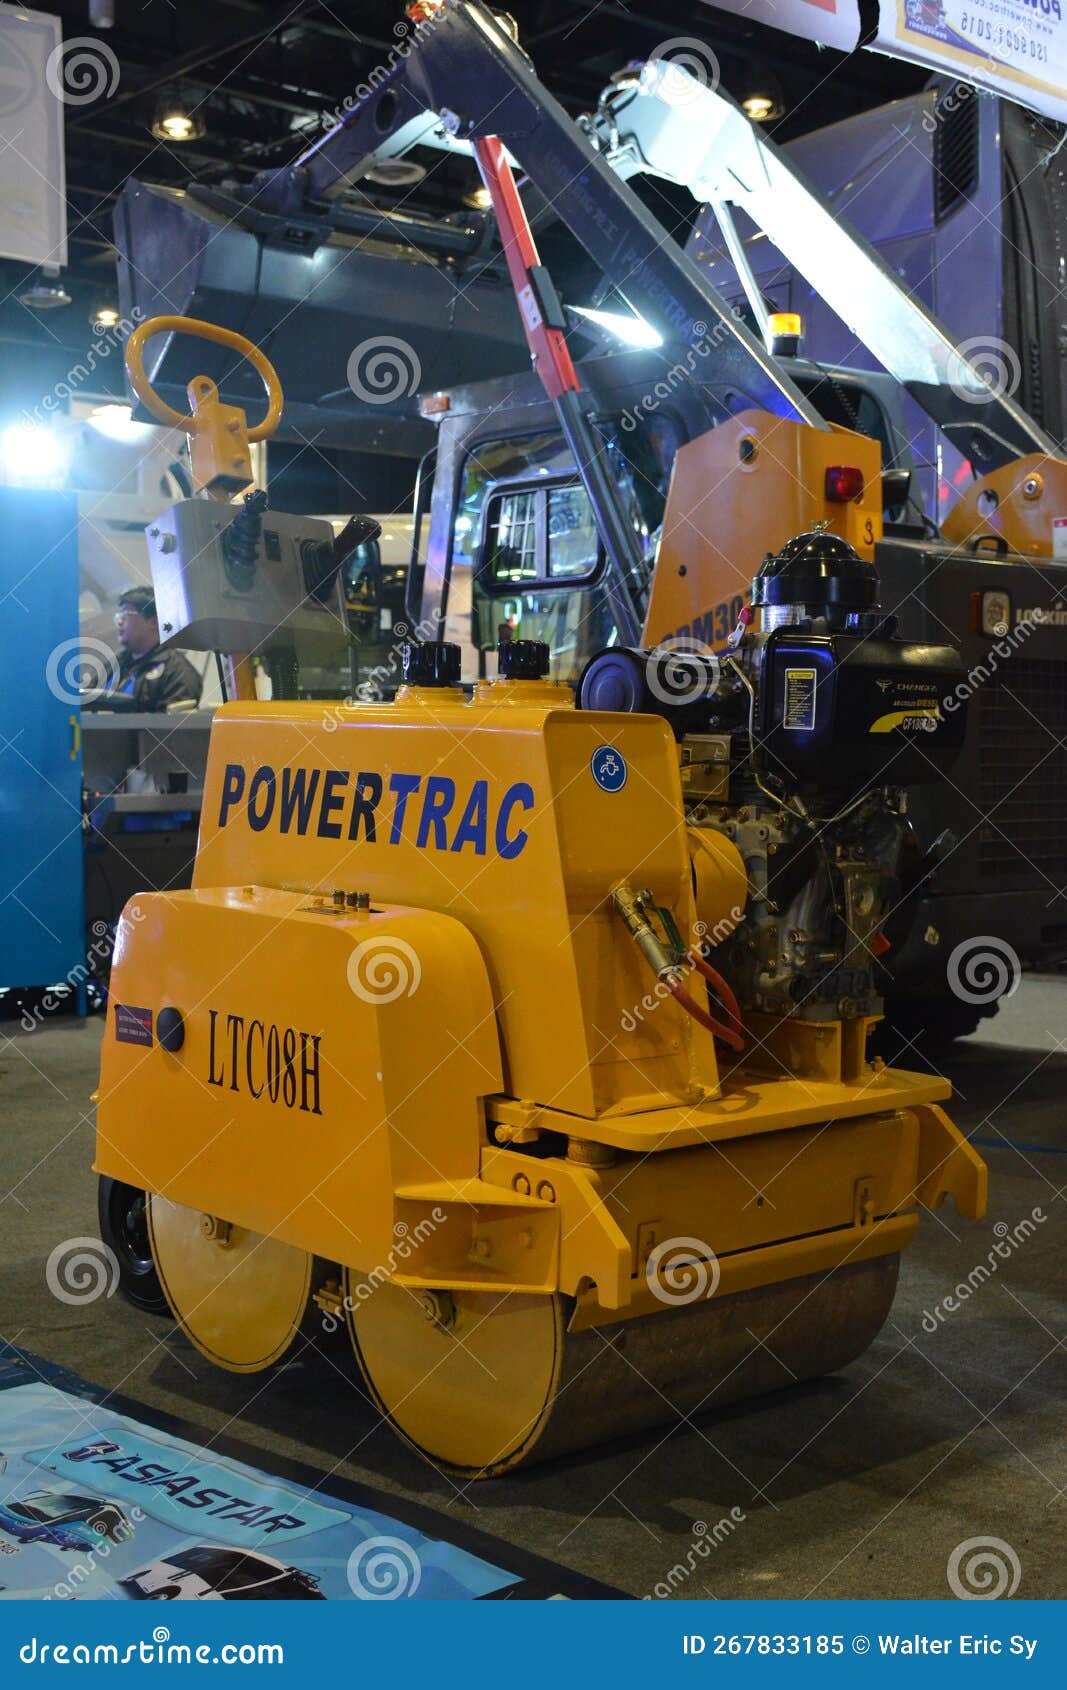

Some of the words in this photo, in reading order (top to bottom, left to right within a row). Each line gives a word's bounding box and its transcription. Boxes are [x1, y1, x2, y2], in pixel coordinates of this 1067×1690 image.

[217, 764, 535, 860] POWERTRAC
[207, 1009, 323, 1116] LTC08H
[97, 1451, 305, 1534] ASIASTAR
